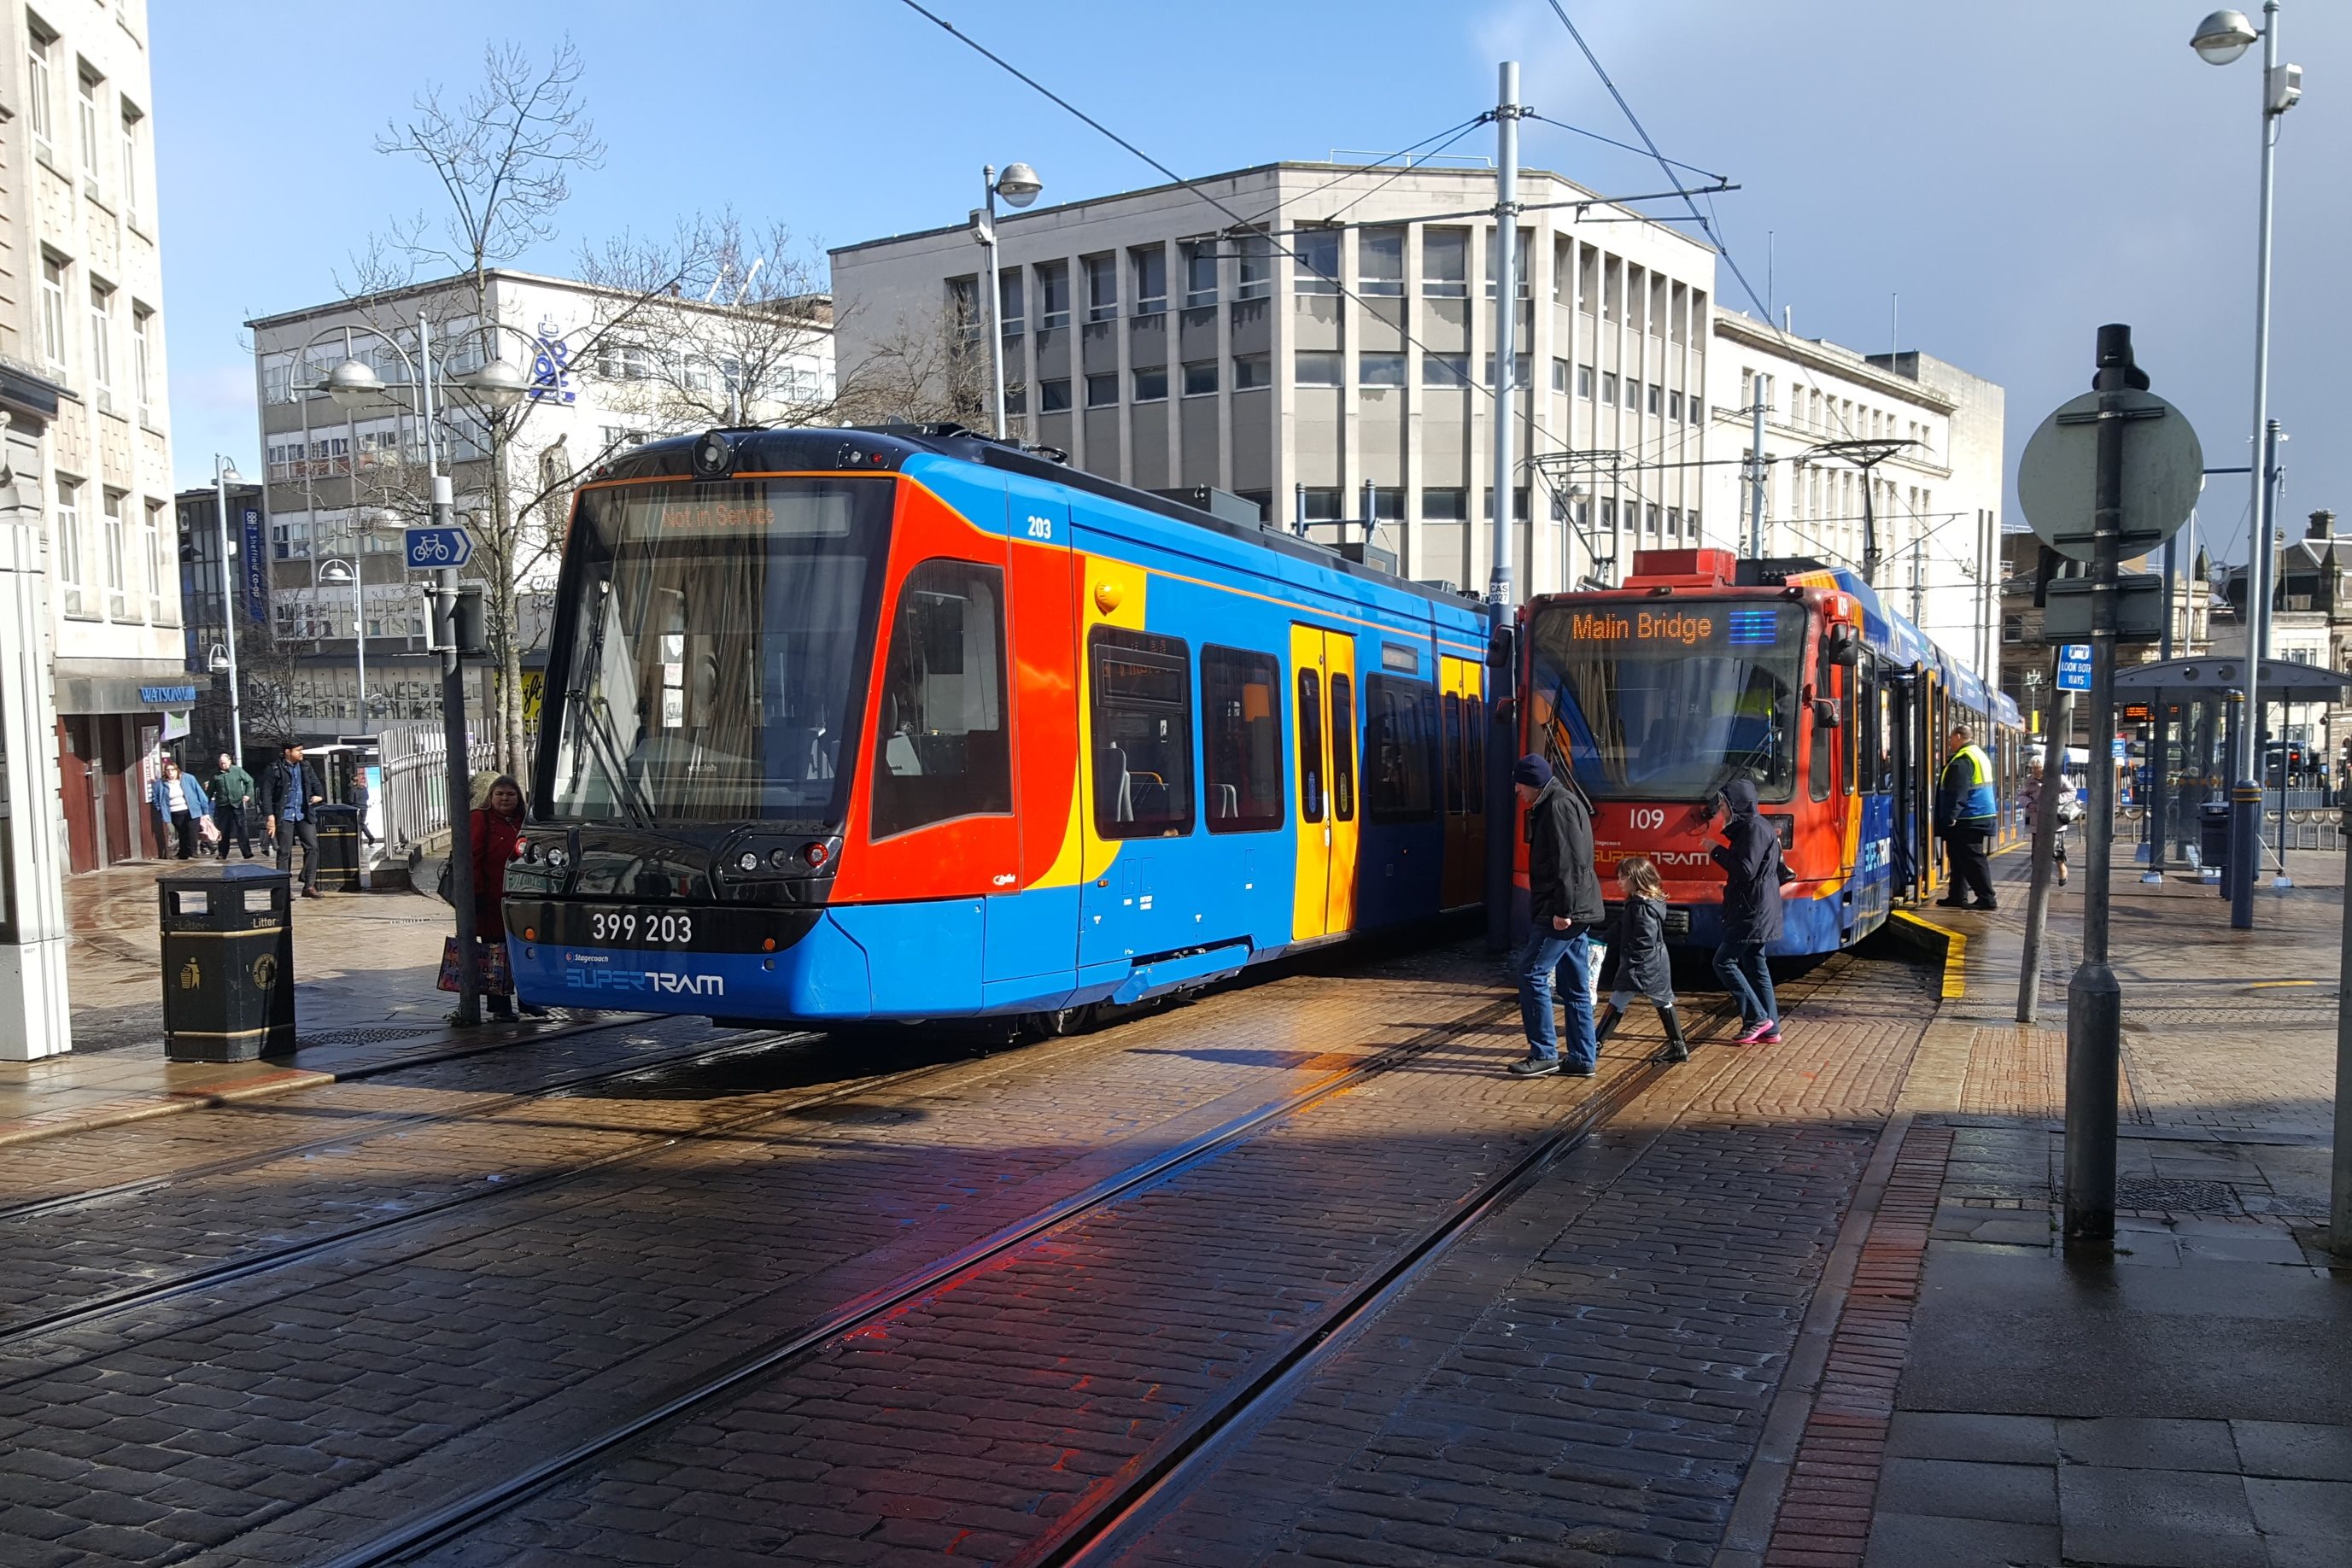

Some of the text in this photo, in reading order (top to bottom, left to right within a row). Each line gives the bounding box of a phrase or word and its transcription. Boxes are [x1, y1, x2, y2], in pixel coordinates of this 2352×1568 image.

[662, 504, 775, 527] Not in Service
[1027, 515, 1051, 540] 203
[249, 535, 259, 570] Sheffield
[1490, 584, 1508, 594] CAS
[1490, 594, 1507, 602] 2027
[1573, 612, 1712, 645] Malin Bridge
[2061, 661, 2077, 672] LOOK
[2068, 674, 2085, 686] WAYS
[1629, 809, 1665, 829] 109
[253, 917, 277, 928] Litter
[592, 913, 692, 943] 399 203
[574, 953, 609, 963] Stagecoach
[566, 967, 724, 996] SUPERTRAM
